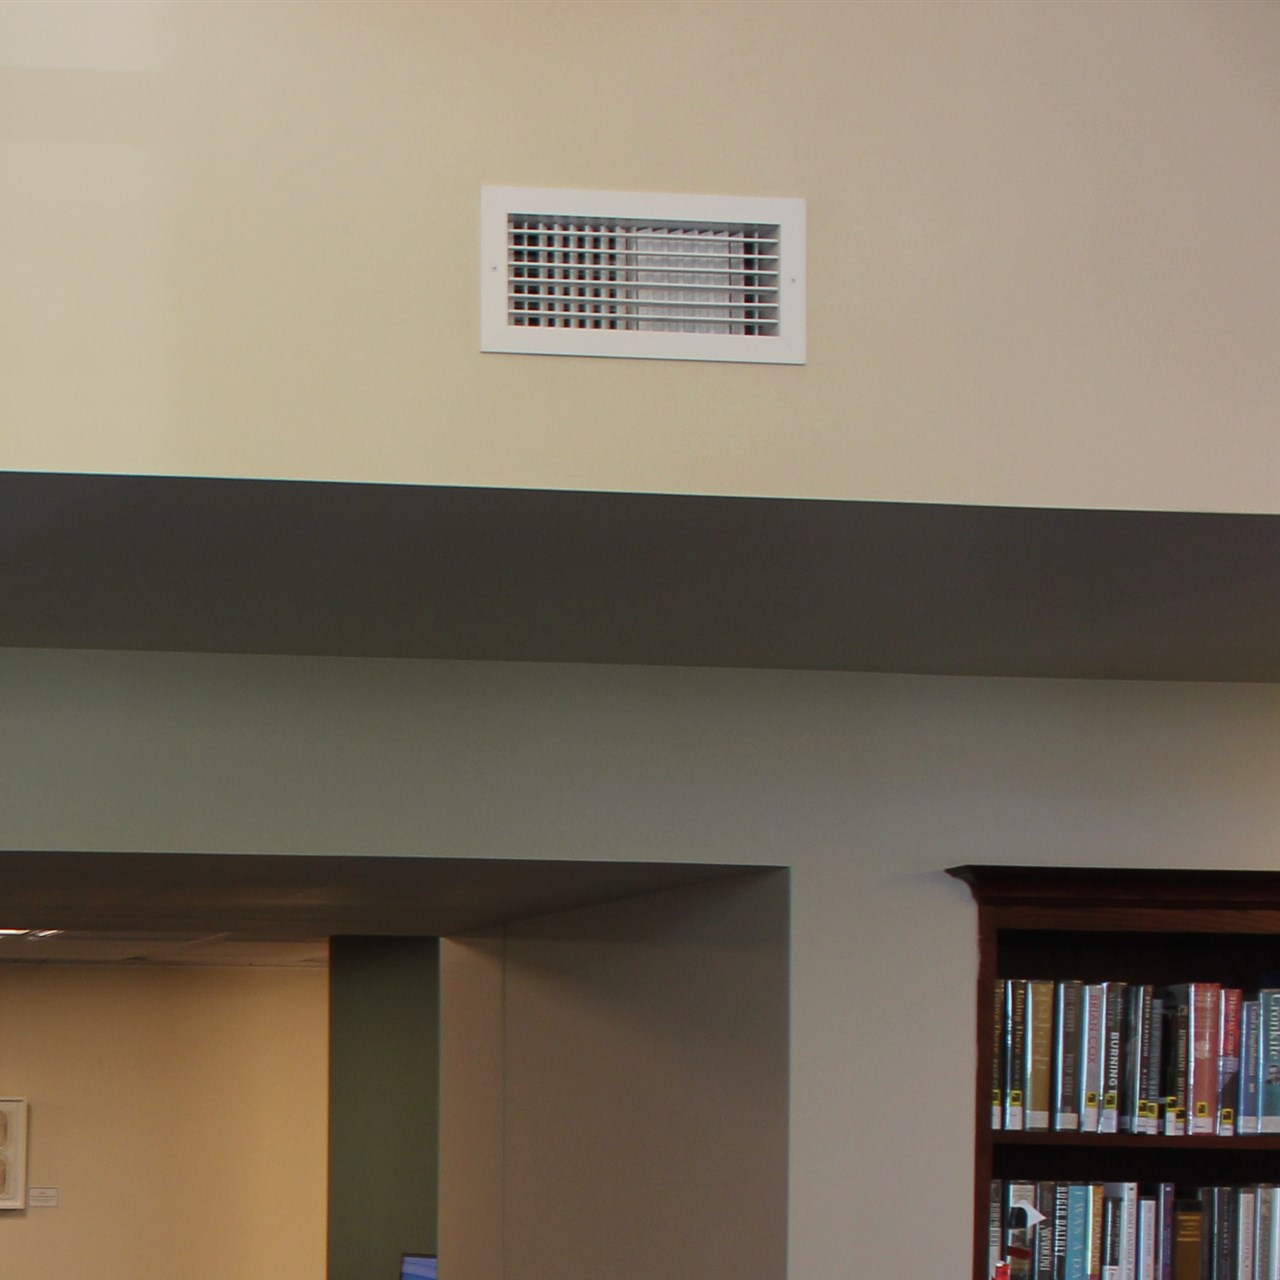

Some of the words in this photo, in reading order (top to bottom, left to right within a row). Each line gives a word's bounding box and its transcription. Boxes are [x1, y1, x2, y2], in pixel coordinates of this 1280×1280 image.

[1089, 994, 1100, 1032] BRIAN
[1088, 1038, 1099, 1063] COX
[1109, 1031, 1120, 1088] BURNING
[1093, 1195, 1103, 1214] VIC
